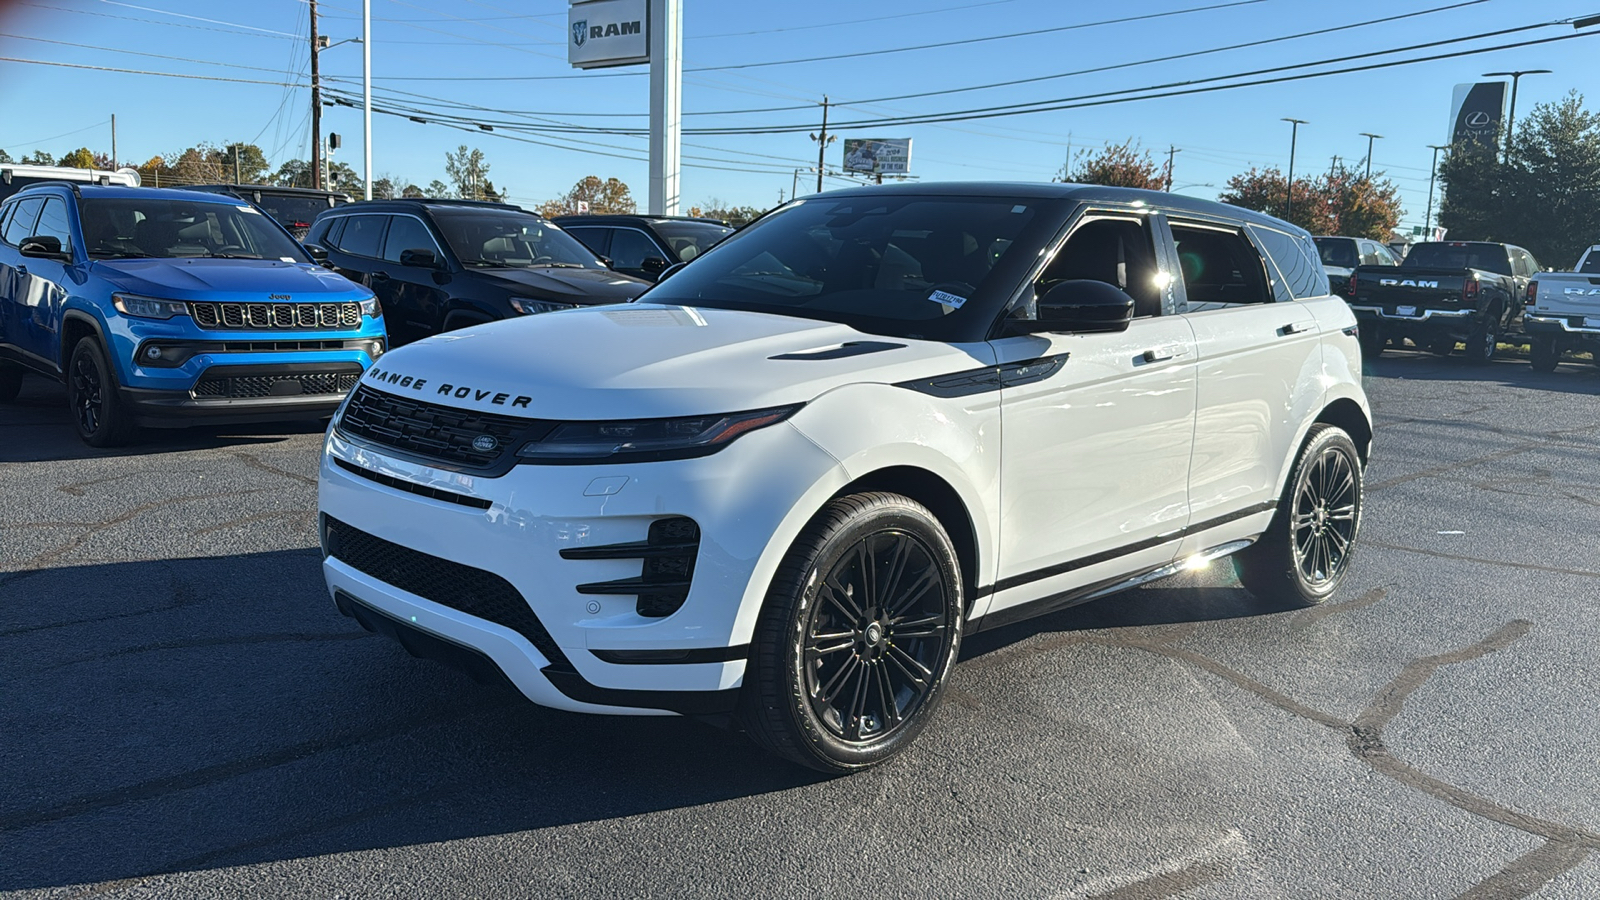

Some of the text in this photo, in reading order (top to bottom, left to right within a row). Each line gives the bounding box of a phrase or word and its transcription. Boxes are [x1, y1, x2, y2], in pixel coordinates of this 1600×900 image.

[590, 20, 641, 39] RAM
[1380, 278, 1439, 288] RAM
[268, 293, 291, 301] Jeep
[369, 367, 533, 408] RANGE ROVER
